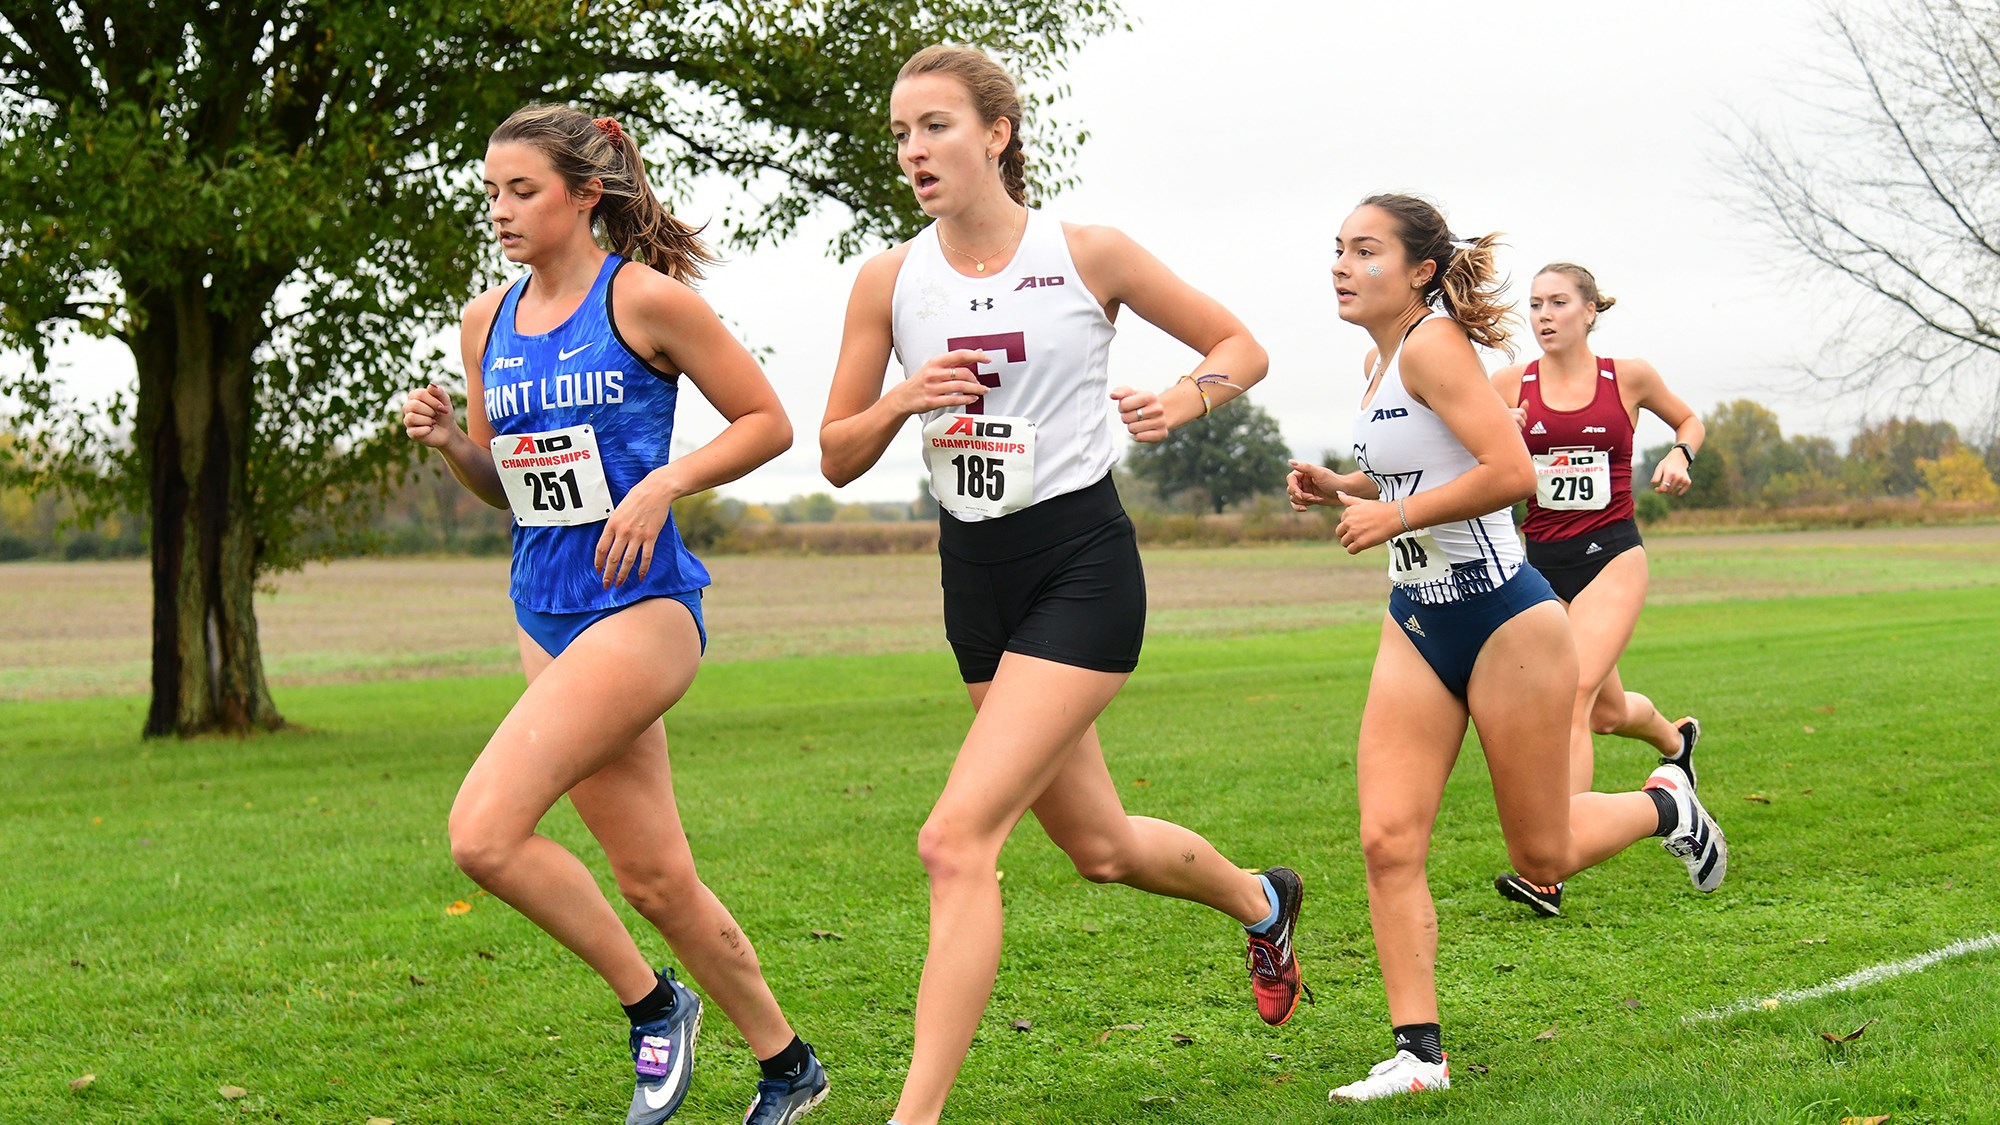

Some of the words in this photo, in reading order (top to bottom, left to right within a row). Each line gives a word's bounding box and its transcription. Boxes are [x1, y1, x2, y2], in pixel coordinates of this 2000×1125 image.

[1013, 275, 1065, 291] A10
[490, 356, 524, 372] A10
[484, 380, 534, 422] AINT
[540, 370, 624, 411] LOUIS
[1370, 407, 1409, 423] A10
[944, 416, 1012, 438] A10
[512, 434, 573, 455] A10
[932, 438, 1026, 454] CHAMPIONSHIPS
[501, 449, 591, 469] CHAMPIONSHIPS
[1549, 455, 1594, 466] A10
[951, 454, 1005, 501] 185
[1538, 466, 1604, 475] CHAMPIONSHIPS
[523, 468, 584, 512] 251
[1551, 476, 1594, 501] 279
